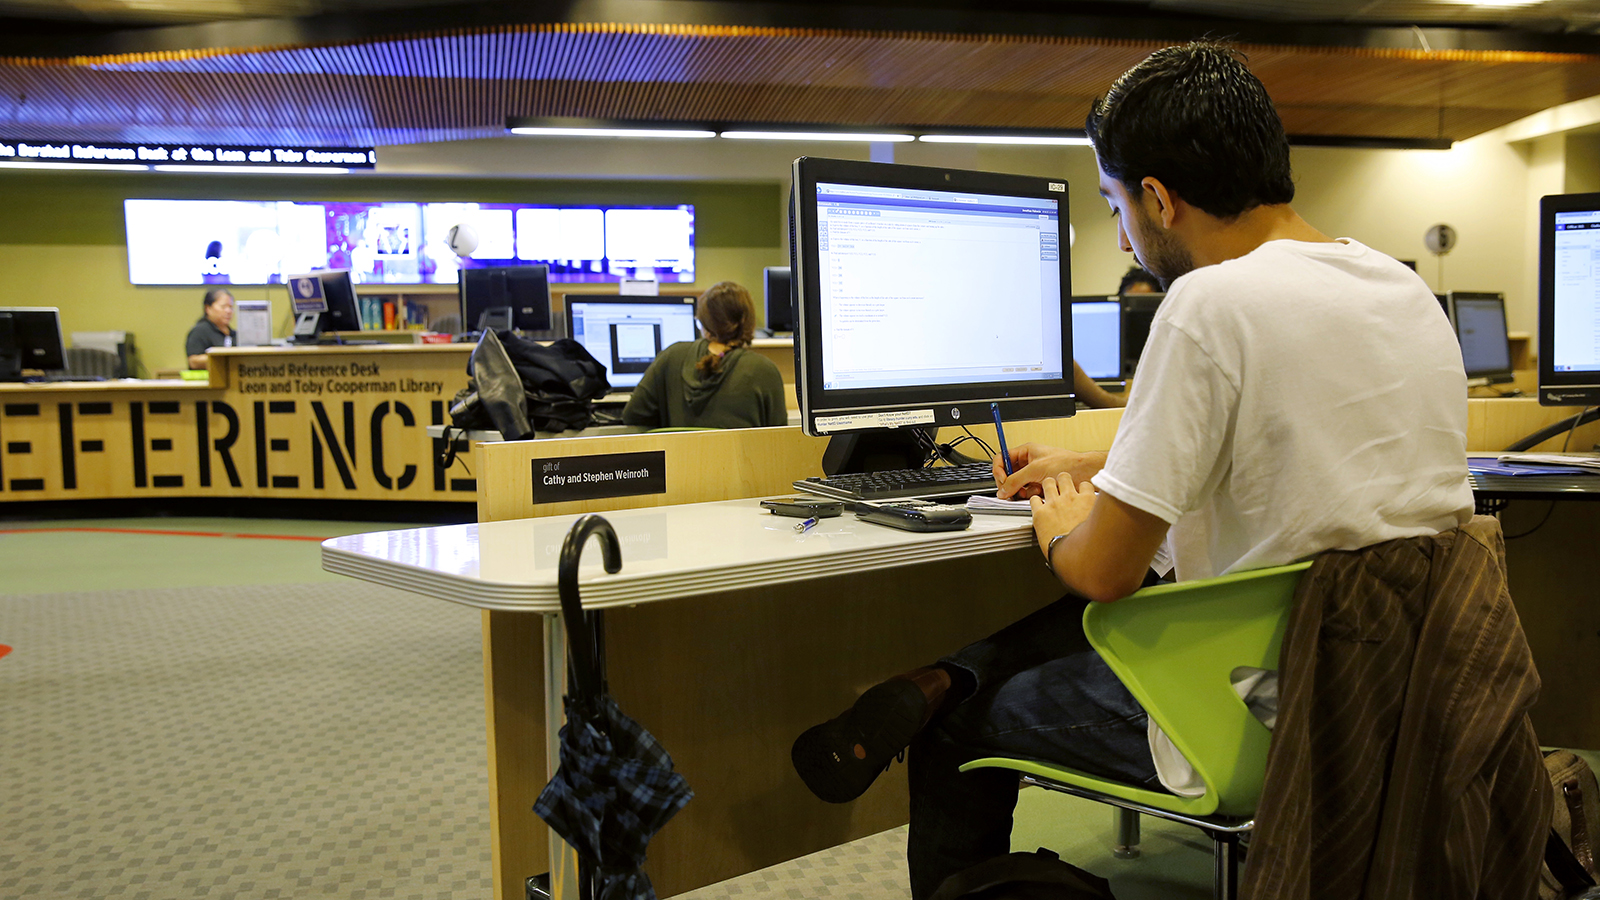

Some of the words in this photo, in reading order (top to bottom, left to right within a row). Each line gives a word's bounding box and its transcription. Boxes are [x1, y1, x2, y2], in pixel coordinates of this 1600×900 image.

[238, 363, 285, 378] Bershad
[288, 362, 348, 378] Reference
[350, 361, 380, 377] Desk
[238, 380, 268, 394] Leon
[270, 380, 291, 394] and
[295, 379, 323, 396] Toby
[326, 378, 397, 397] Cooperman
[399, 378, 443, 396] Library
[542, 462, 553, 473] gift
[553, 461, 560, 471] of
[543, 475, 566, 485] Cathy
[567, 473, 582, 484] and
[583, 471, 614, 483] Stephen
[614, 468, 649, 480] Weinroth
